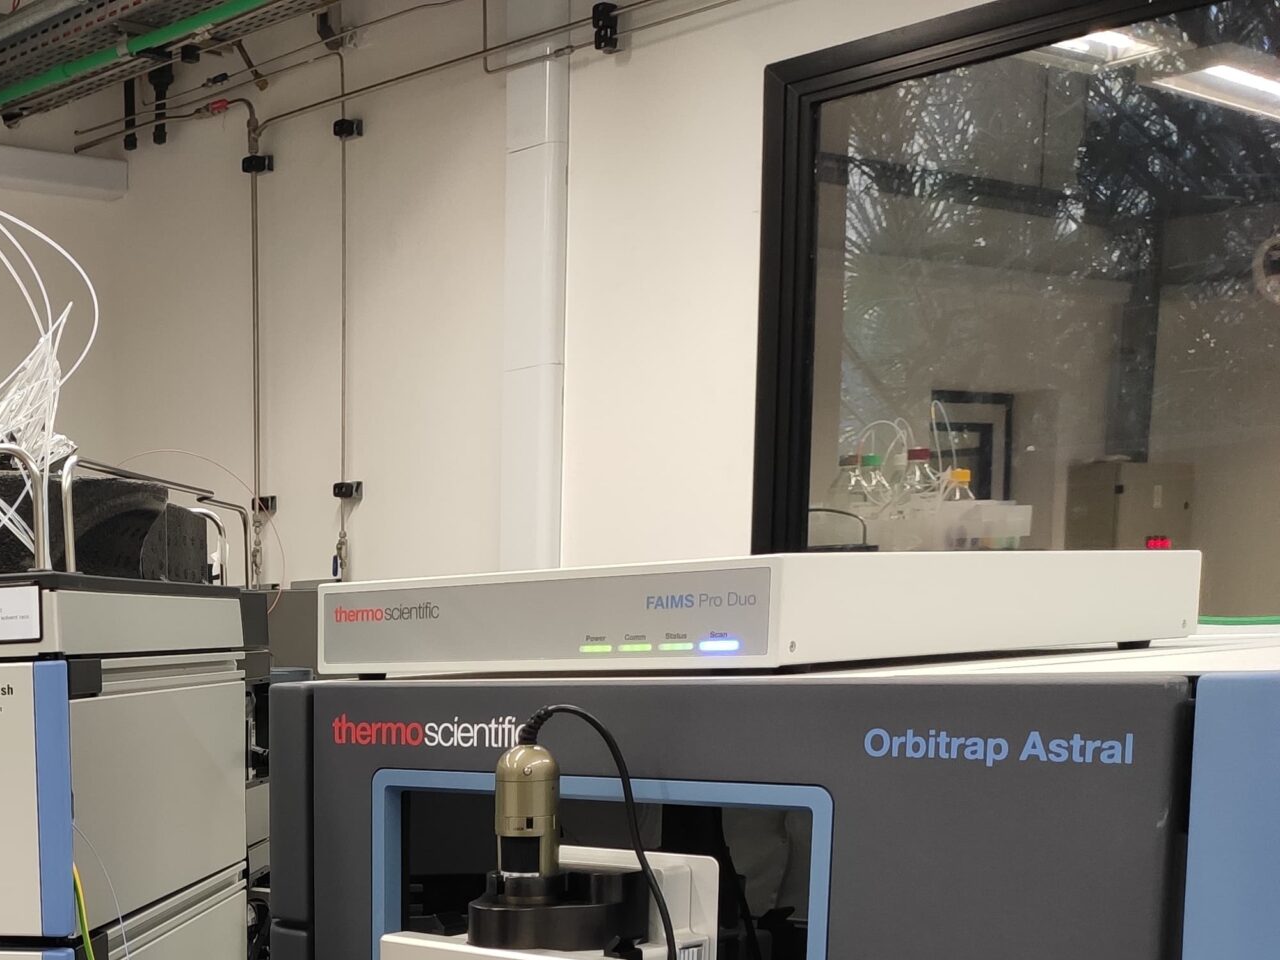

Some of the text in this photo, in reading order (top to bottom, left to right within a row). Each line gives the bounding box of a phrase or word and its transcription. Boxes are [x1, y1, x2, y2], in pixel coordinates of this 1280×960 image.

[646, 591, 757, 610] FAIMS Pro Duo
[585, 634, 607, 642] Power
[624, 633, 647, 641] Comm
[665, 632, 688, 640] Status
[709, 631, 728, 639] Scan
[864, 728, 1134, 767] Orbitrap Astral
